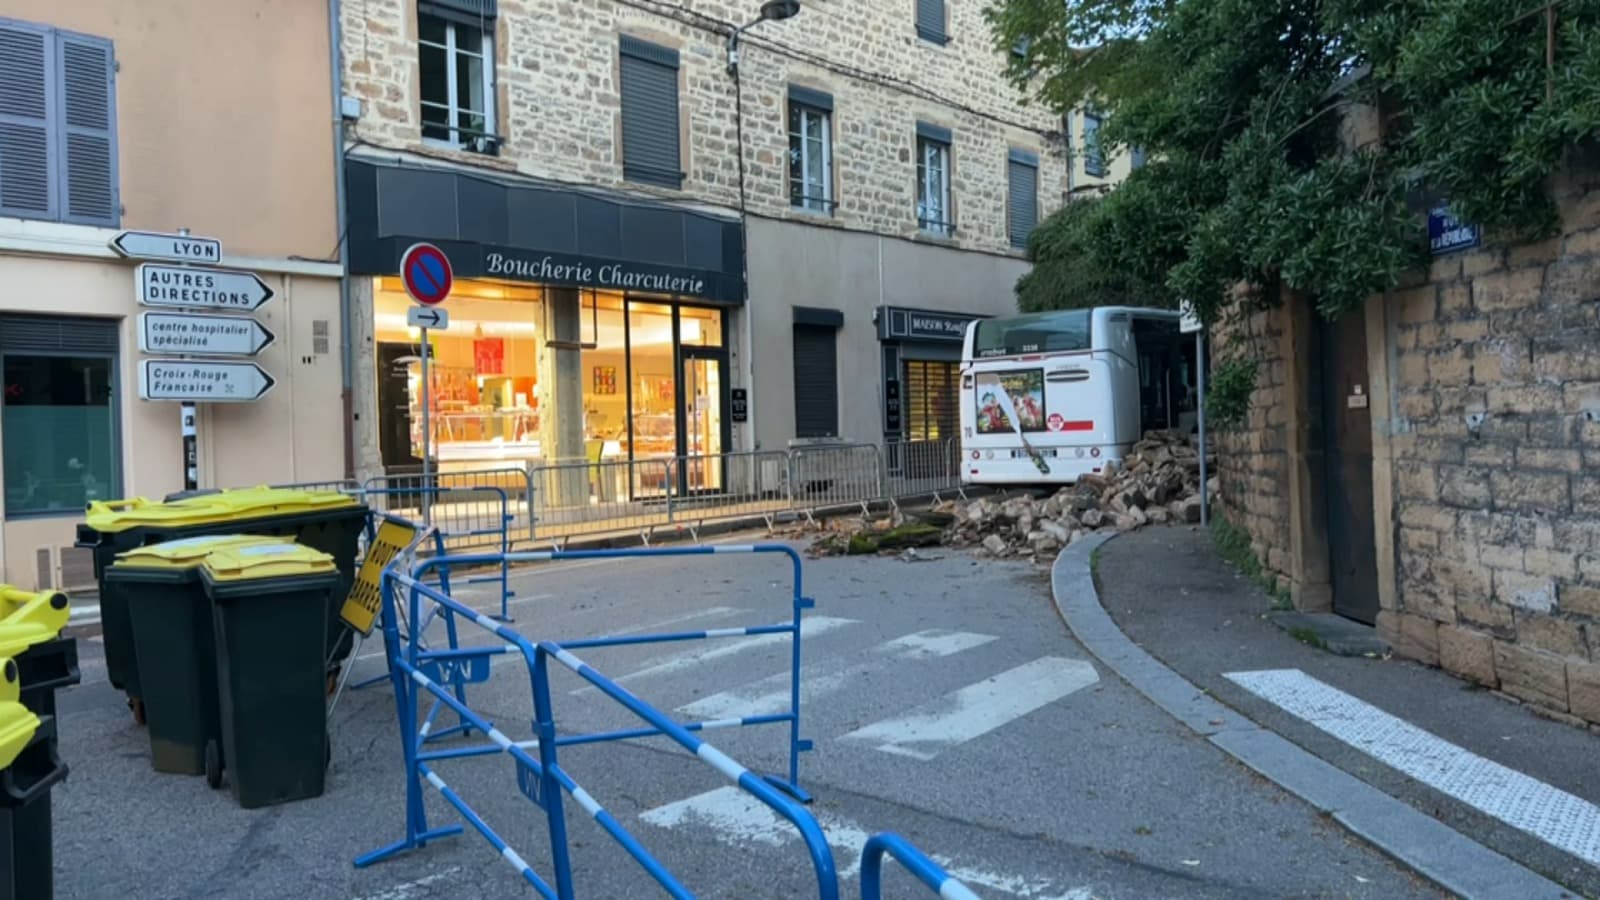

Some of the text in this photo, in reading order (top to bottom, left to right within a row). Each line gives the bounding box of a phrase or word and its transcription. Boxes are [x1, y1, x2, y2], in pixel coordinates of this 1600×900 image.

[173, 241, 214, 257] LYON
[150, 271, 214, 288] AUTRES
[486, 253, 704, 293] Boucherie Charcuterie
[150, 286, 249, 305] DIRECTIONS
[152, 322, 248, 335] centre hospitalier
[153, 368, 228, 383] Croix-Rouge
[370, 540, 401, 566] ROUT
